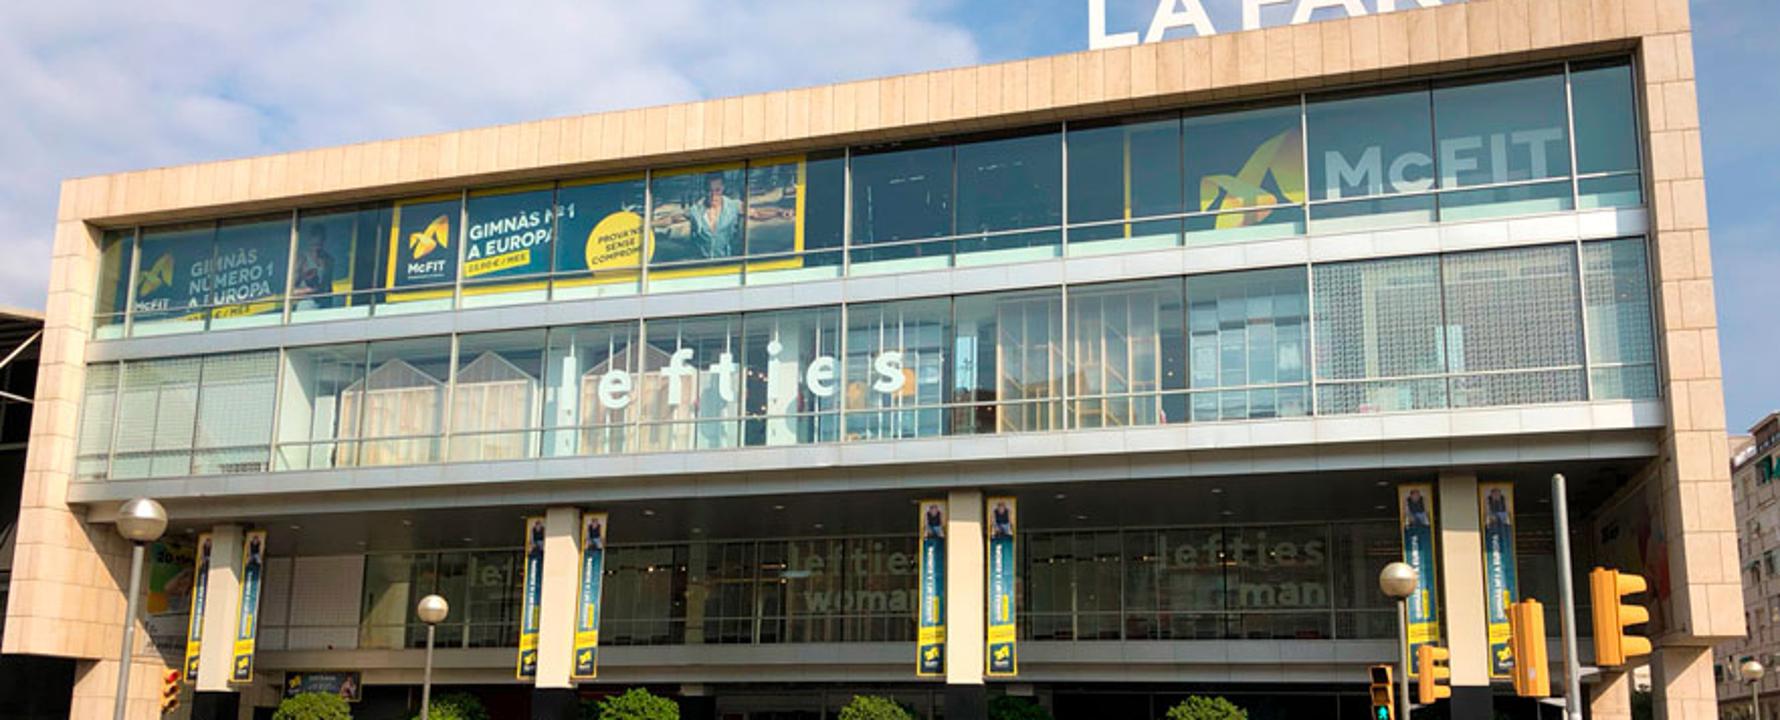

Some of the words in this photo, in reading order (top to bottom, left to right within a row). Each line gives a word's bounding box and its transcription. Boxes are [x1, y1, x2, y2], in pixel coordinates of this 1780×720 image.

[1088, 0, 1216, 50] LA
[1325, 127, 1562, 200] McFIT
[470, 208, 540, 240] GIMNÀS
[407, 260, 446, 274] McFIT
[468, 244, 480, 260] A
[561, 340, 906, 414] lefties
